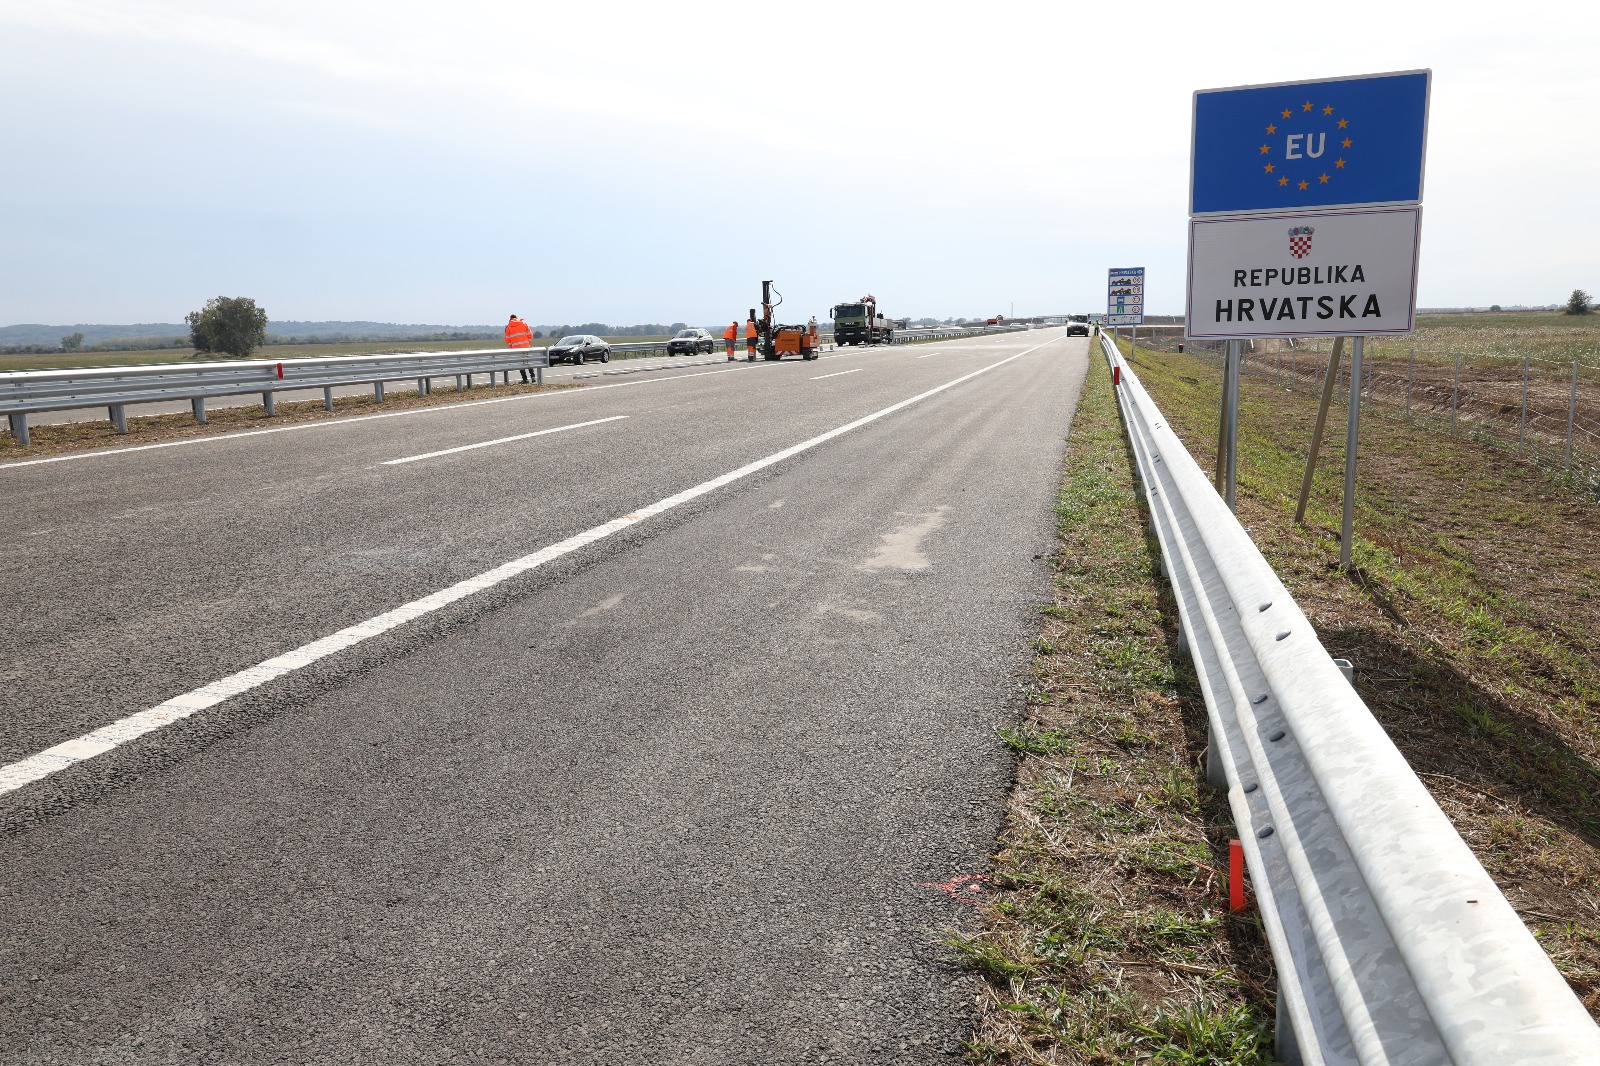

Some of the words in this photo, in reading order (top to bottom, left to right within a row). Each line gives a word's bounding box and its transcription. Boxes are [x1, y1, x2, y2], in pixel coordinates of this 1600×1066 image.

[1285, 132, 1325, 160] EU
[1234, 264, 1366, 287] REPUBLIKA
[1216, 293, 1382, 322] HRVATSKA
